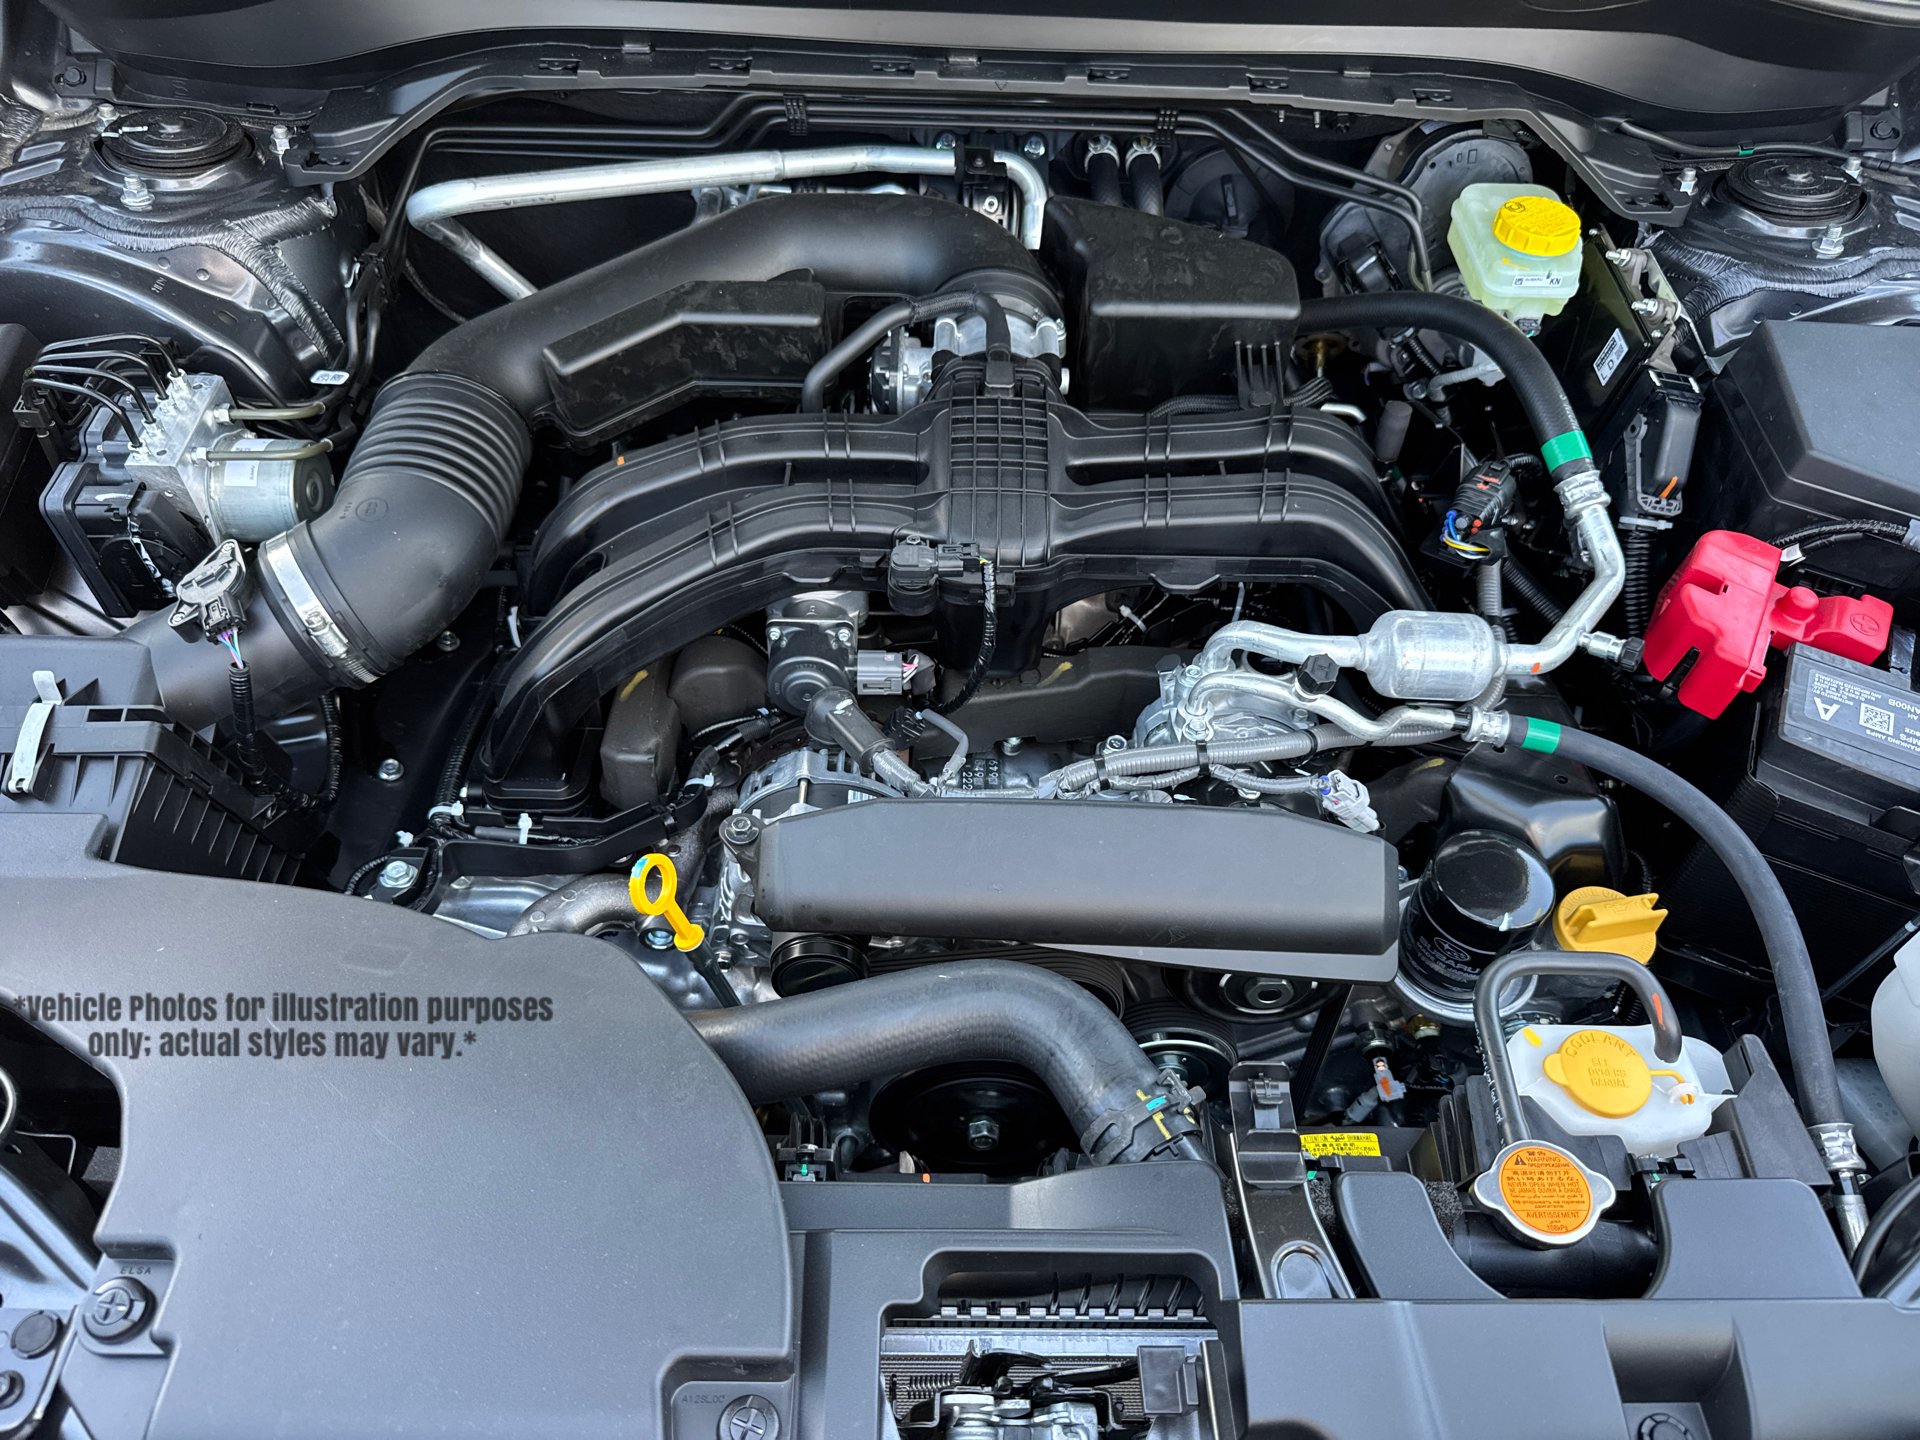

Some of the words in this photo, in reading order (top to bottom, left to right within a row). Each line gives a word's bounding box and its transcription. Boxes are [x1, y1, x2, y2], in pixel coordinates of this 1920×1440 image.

[1606, 359, 1615, 370] D
[1814, 696, 1840, 721] A
[1908, 712, 1918, 720] AH
[1866, 729, 1886, 740] AMPS
[1416, 942, 1435, 962] MADE
[1420, 936, 1481, 974] SUBARU
[1565, 1032, 1636, 1058] COOLANT
[1591, 1058, 1610, 1067] SEE
[1590, 1078, 1630, 1088] MANUAL
[120, 1265, 152, 1275] ELSA
